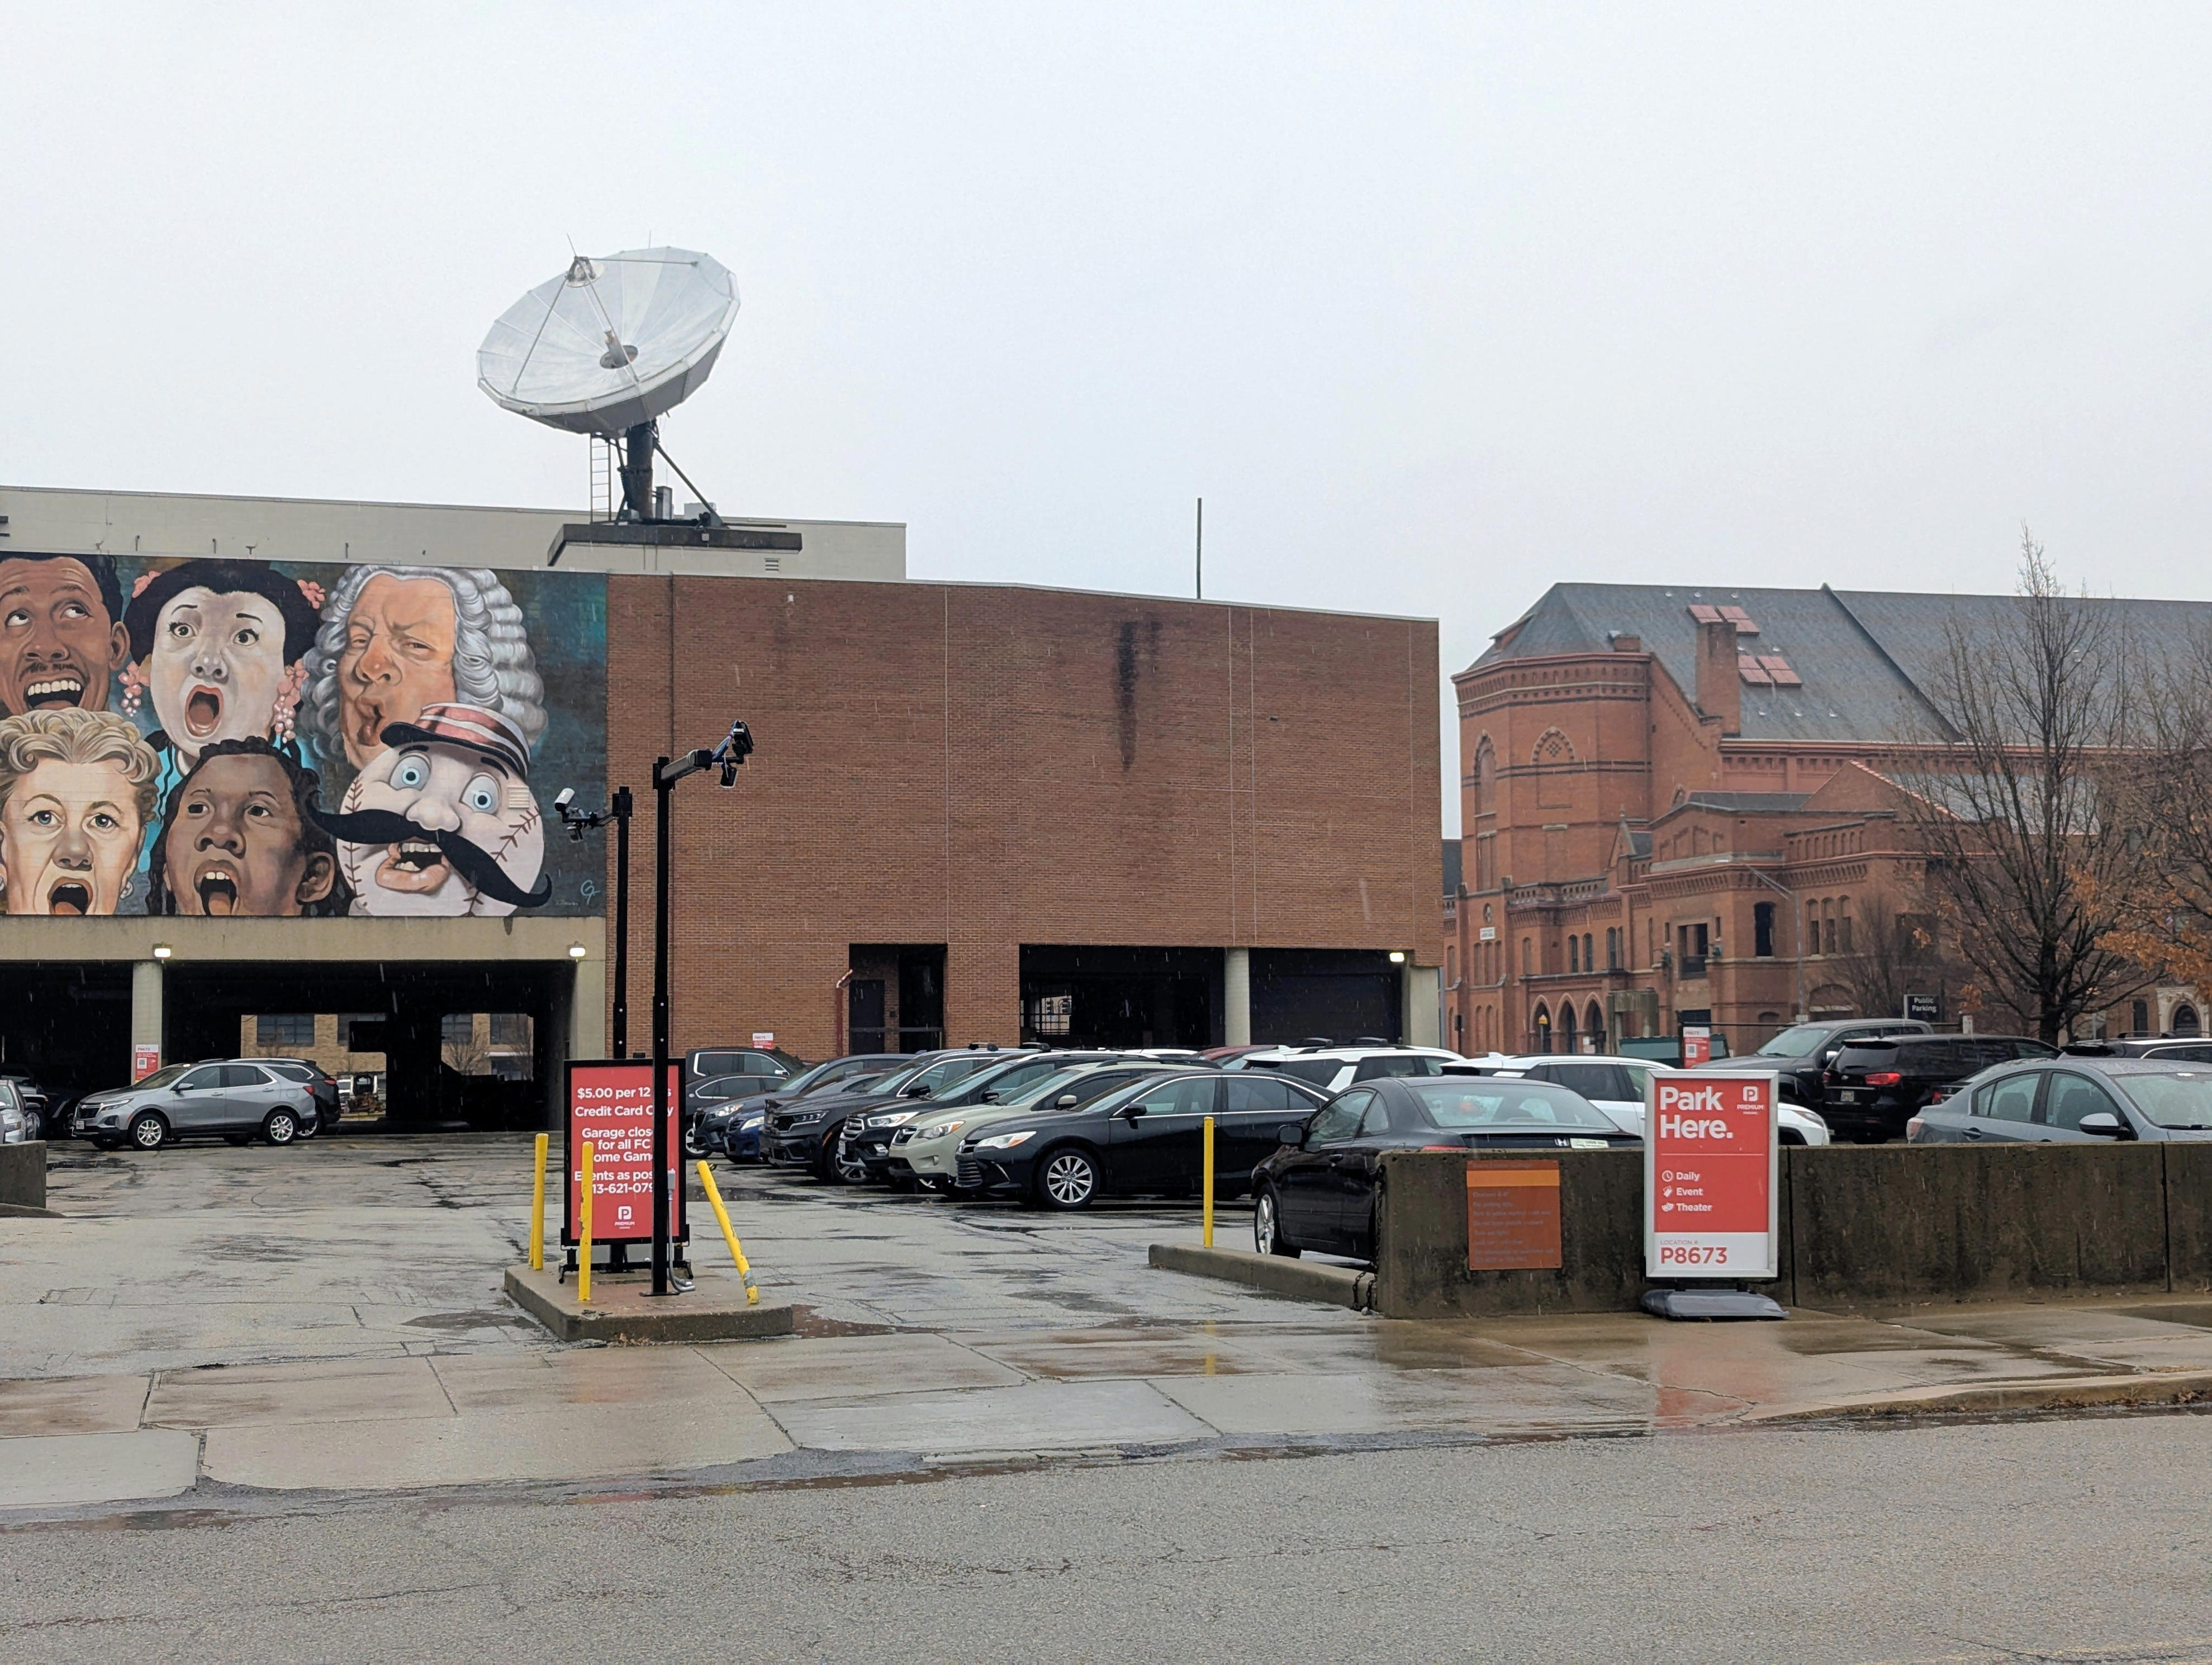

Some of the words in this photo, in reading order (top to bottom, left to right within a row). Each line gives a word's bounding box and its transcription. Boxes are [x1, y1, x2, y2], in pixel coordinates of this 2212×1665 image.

[1912, 1005, 1937, 1013] Parking
[577, 1087, 613, 1100] $5.00
[615, 1089, 636, 1100] per
[638, 1087, 651, 1097] 12
[1660, 1086, 1724, 1111] Park
[575, 1106, 612, 1117] Credit
[614, 1105, 643, 1116] Card
[582, 1128, 625, 1139] Garage
[628, 1126, 653, 1137] clos
[1660, 1114, 1733, 1139] Here.
[598, 1140, 615, 1150] for
[617, 1139, 631, 1149] all
[634, 1139, 651, 1149] FC
[594, 1153, 620, 1162] ome
[623, 1151, 653, 1162] Gam
[574, 1170, 614, 1182] Eents
[616, 1171, 630, 1181] as
[1676, 1171, 1700, 1182] Daily
[592, 1182, 653, 1194] 13-621-079
[1676, 1187, 1703, 1196] Event
[1676, 1202, 1712, 1211] Theater
[1660, 1247, 1727, 1264] P8673
